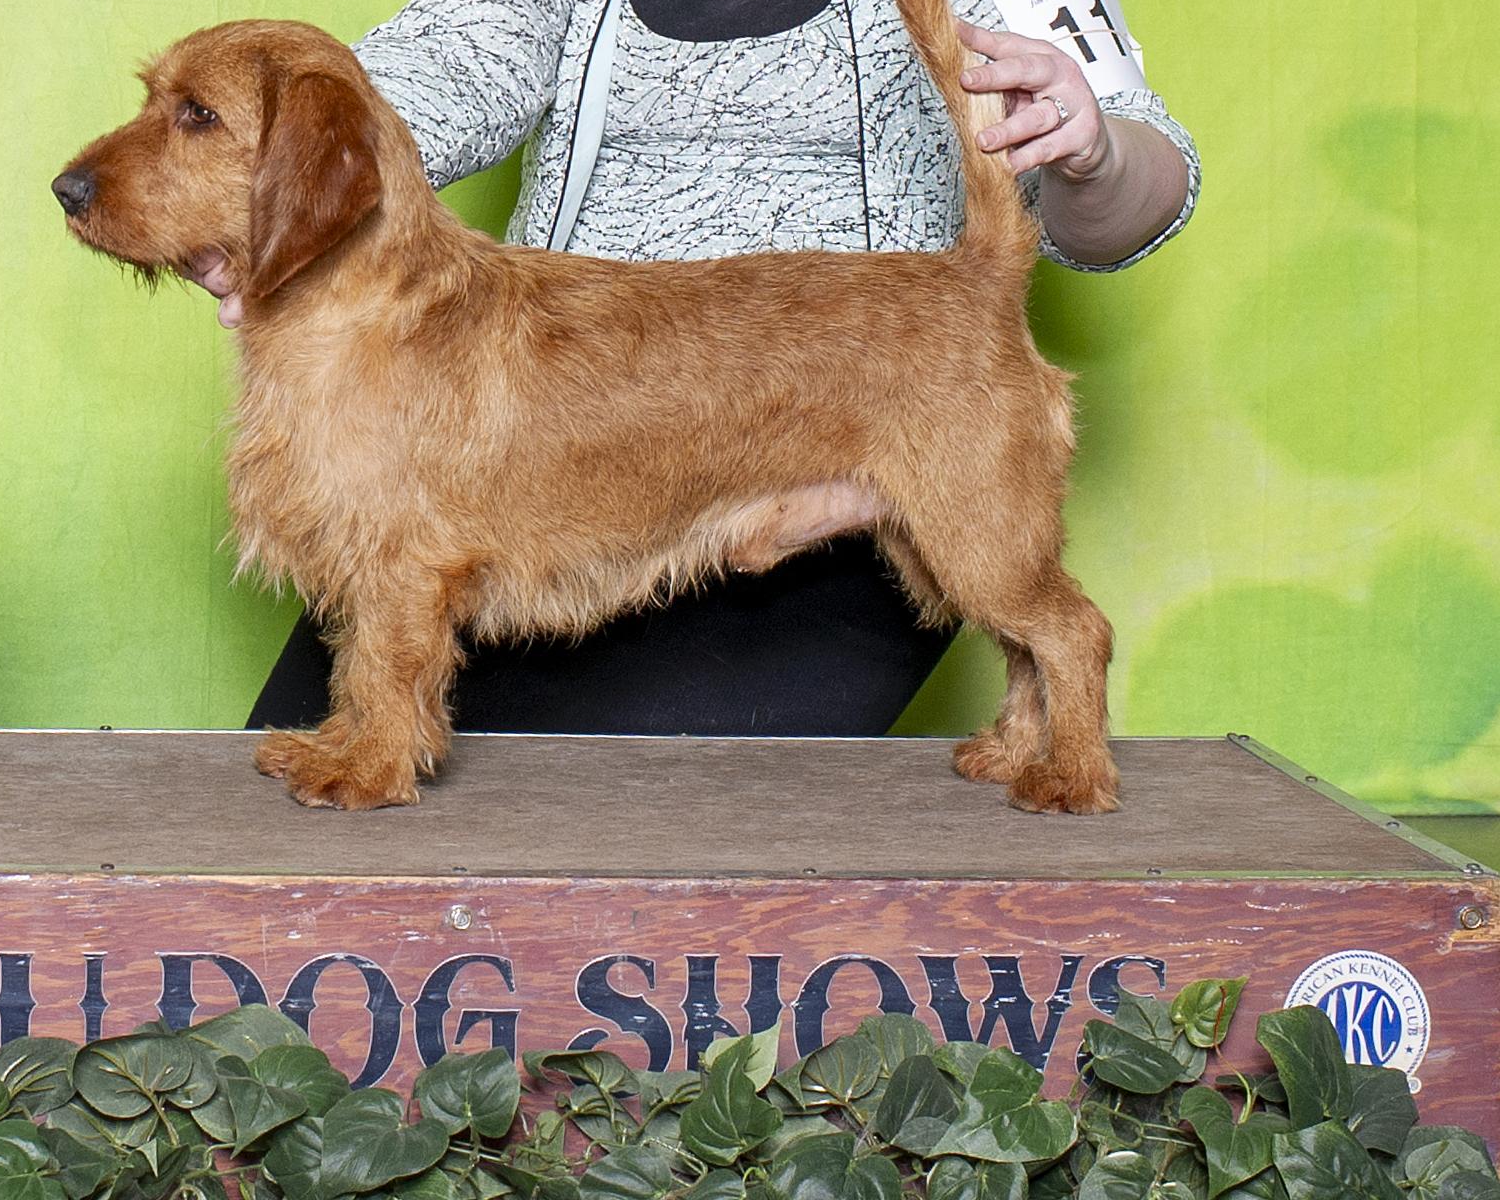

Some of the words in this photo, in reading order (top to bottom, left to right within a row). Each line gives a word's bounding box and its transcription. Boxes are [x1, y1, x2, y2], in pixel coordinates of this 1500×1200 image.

[154, 952, 522, 1091] DOG
[1301, 966, 1344, 1003] RICAN
[1348, 962, 1405, 996] KENNEL
[1401, 995, 1419, 1037] CLUB
